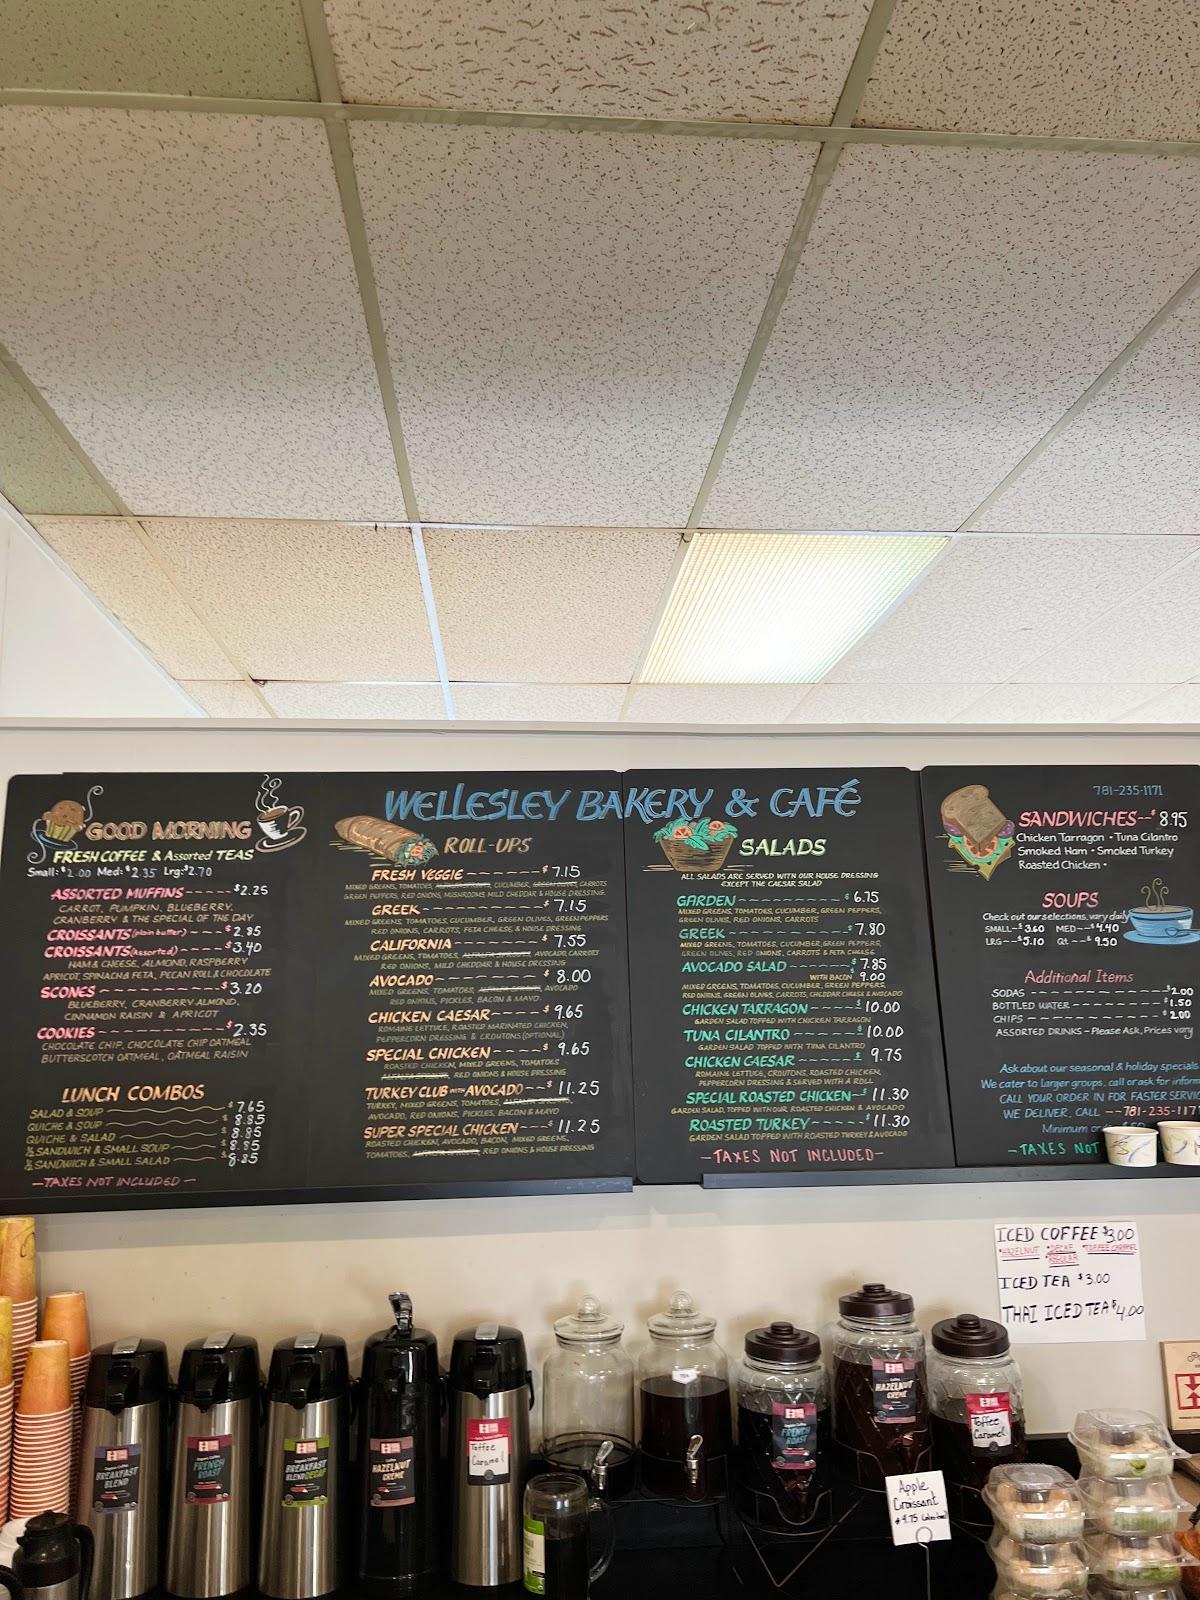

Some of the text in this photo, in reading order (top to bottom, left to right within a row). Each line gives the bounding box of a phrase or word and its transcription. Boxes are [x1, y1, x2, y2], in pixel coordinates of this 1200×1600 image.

[1093, 785, 1163, 796] 781-235-1171
[384, 778, 862, 825] WELLESLEY BAKERY & CAFÉ
[1019, 811, 1137, 827] SANDWICHES
[85, 821, 251, 840] GOOD MORNING
[1016, 832, 1178, 844] Chicken Tarragon Tuna Cilantro
[444, 837, 532, 854] ROLL-UPS
[739, 838, 827, 856] SALADS
[1018, 846, 1174, 857] Smoked Ham Smoked Turkey
[53, 849, 254, 862] FRESH COFFEE & Assorted TEAS
[1019, 860, 1100, 870] Roasted Chicken
[371, 868, 464, 882] FRESH VEGGIE
[681, 872, 694, 880] ALL
[696, 872, 726, 880] SALADS
[728, 872, 743, 880] ARE
[746, 872, 774, 880] SERVED
[777, 872, 796, 880] WITH
[798, 872, 814, 880] OUR
[840, 871, 878, 879] DRESSING
[50, 888, 122, 900] ASSORTED
[126, 888, 184, 899] MUFFINS
[1042, 892, 1099, 909] SOUPS
[677, 895, 736, 907] GARDEN
[372, 904, 420, 916] GREEK
[983, 913, 1009, 921] Check
[1090, 914, 1108, 923] vary
[1109, 911, 1130, 922] daily
[679, 928, 725, 940] GREEK
[985, 924, 1012, 932] SMALL
[1056, 924, 1076, 932] MED
[370, 938, 452, 952] CALIFORNIA
[986, 938, 1002, 946] LRG
[682, 961, 787, 973] AVOCADO SALAD
[369, 974, 434, 987] AVOCADO
[1024, 969, 1133, 984] Additional Items
[40, 986, 96, 998] SCONES
[992, 989, 1025, 998] SODAS
[682, 1003, 808, 1016] CHICKEN TARRAGON
[992, 1002, 1035, 1010] BOTTLED
[368, 1009, 490, 1024] CHICKEN CAESAR
[993, 1015, 1023, 1023] CHIPS
[37, 1027, 96, 1040] COOKIES
[684, 1029, 790, 1042] TUNA CILANTRO
[996, 1028, 1044, 1037] ASSORTED
[1092, 1027, 1121, 1035] Please
[1144, 1026, 1172, 1034] Prices
[1174, 1027, 1193, 1039] vary
[366, 1047, 490, 1062] SPECIAL CHICKEN
[684, 1055, 794, 1068] CHICKEN CAESAR
[62, 1085, 204, 1103] LUNCH COMBOS
[365, 1084, 524, 1100] TURKEY CLUB AVOCADO
[686, 1090, 851, 1104] SPECIAL ROASTED CHICKEN
[1000, 1092, 1168, 1104] CALL YOUR ORDER IN FOR FASTER
[1003, 1110, 1020, 1119] WE
[1076, 1108, 1100, 1117] CALL
[364, 1122, 518, 1139] SUPER SPECIAL CHICKEN
[689, 1118, 810, 1132] ROASTED TURKEY
[1042, 1124, 1087, 1133] Minimum
[1020, 1143, 1100, 1155] TAXES NOT
[770, 1150, 798, 1162] NOT
[86, 1177, 113, 1186] NOT
[996, 1228, 1034, 1242] ICED
[1041, 1227, 1098, 1241] COFFEE
[998, 1277, 1037, 1290] ICED
[1043, 1275, 1070, 1287] TEA
[1002, 1305, 1038, 1323] THAI
[1045, 1303, 1082, 1321] ICED
[1085, 1301, 1109, 1315] TEA
[875, 1380, 913, 1392] HAZELNUT
[974, 1417, 1000, 1426] Toffee
[973, 1430, 1007, 1440] Caramel
[471, 1443, 496, 1451] Toffee
[286, 1460, 327, 1473] BREAKFAST
[471, 1456, 505, 1466] Caramel
[96, 1467, 139, 1481] BREAKFAST
[104, 1478, 129, 1489] BLEND
[899, 1479, 928, 1495] Apple
[894, 1495, 939, 1511] Croissant
